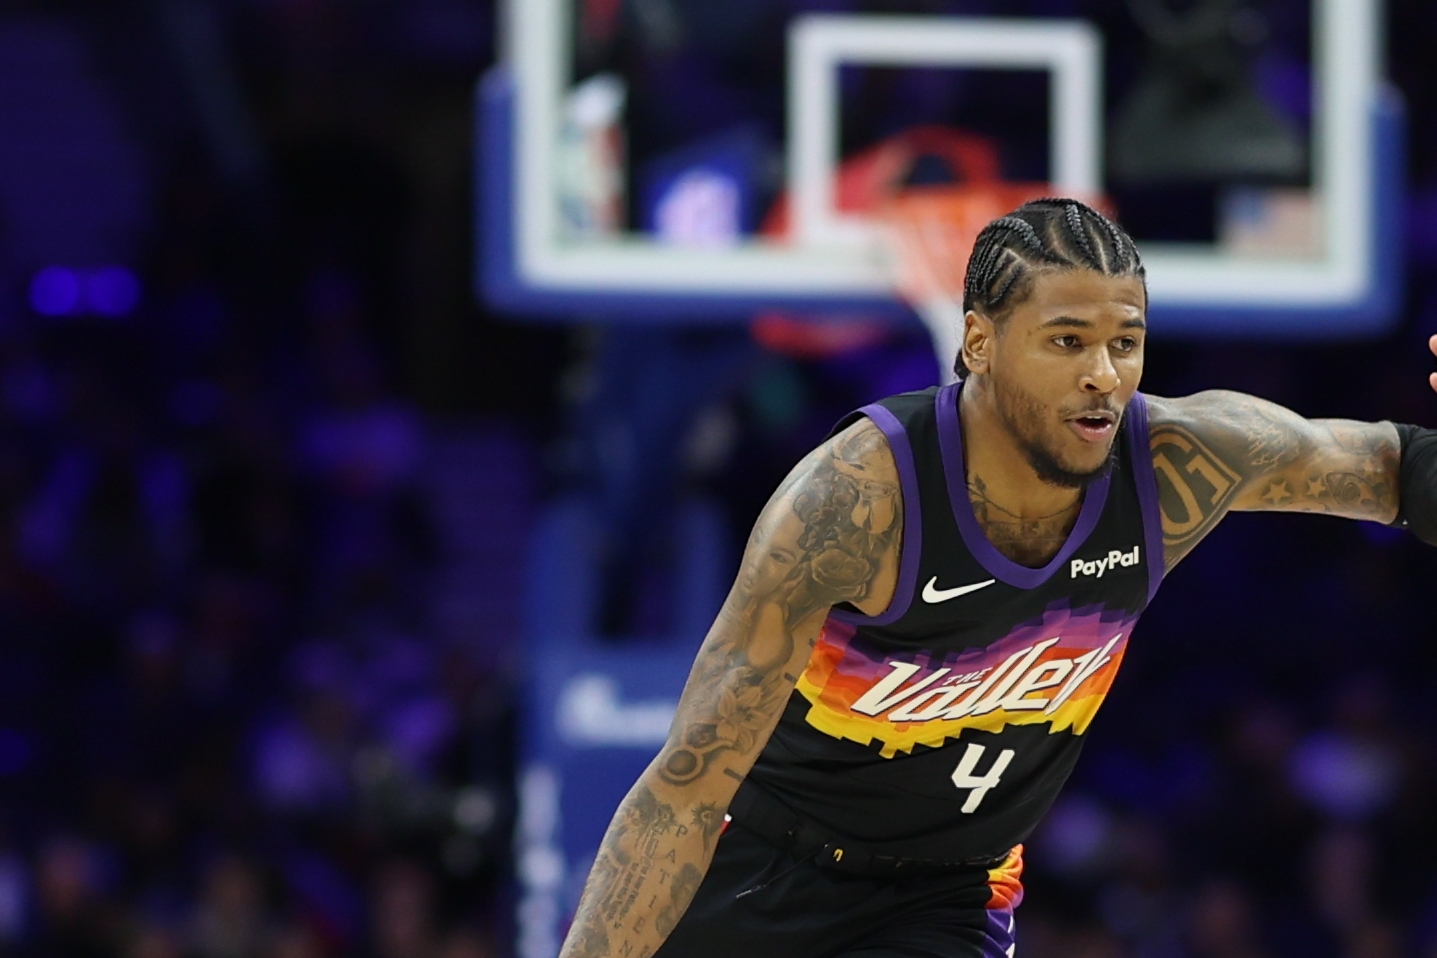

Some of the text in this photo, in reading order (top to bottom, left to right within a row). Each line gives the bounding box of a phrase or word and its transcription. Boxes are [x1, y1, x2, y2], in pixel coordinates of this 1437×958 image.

[1071, 546, 1140, 579] PayPal
[850, 633, 1122, 722] Valley
[942, 666, 993, 686] THE
[951, 743, 1015, 814] 4
